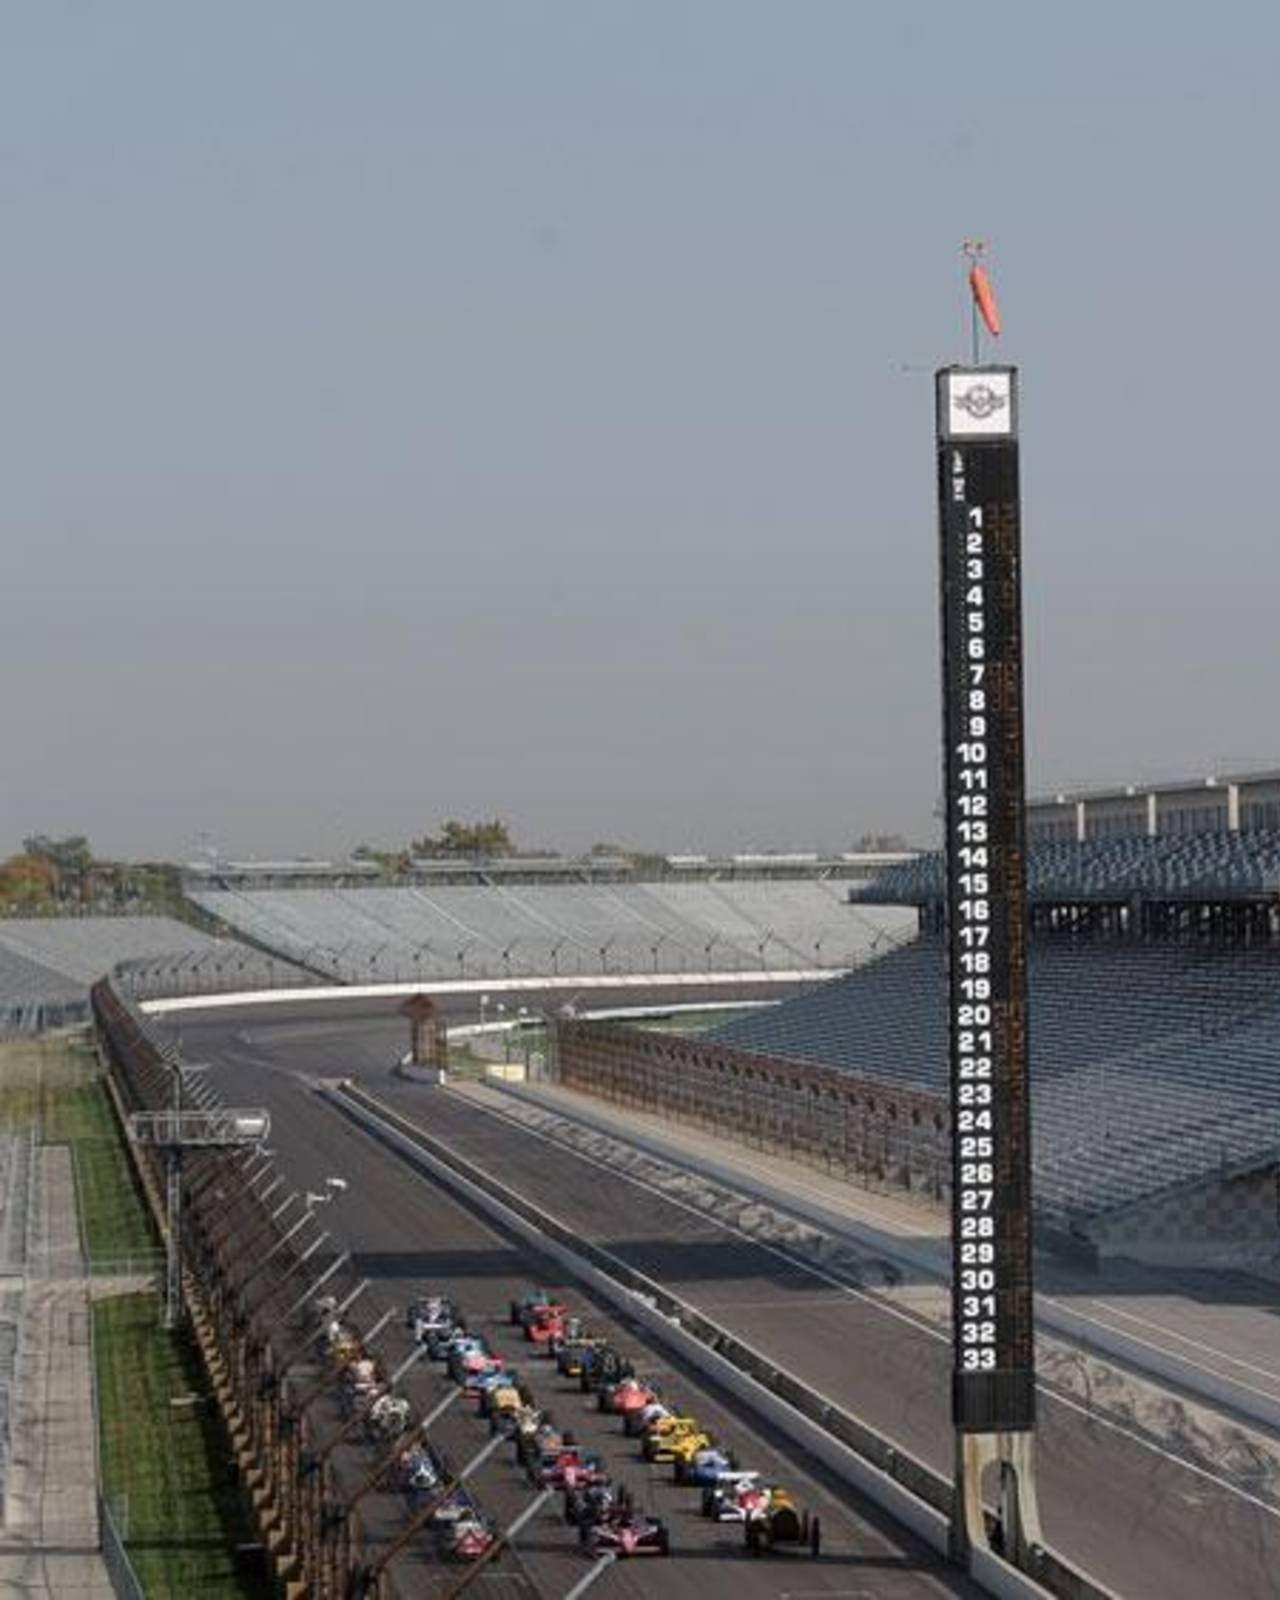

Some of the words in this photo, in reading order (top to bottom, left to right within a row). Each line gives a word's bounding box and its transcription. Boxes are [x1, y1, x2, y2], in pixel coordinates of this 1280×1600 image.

[968, 506, 983, 528] 1
[966, 532, 983, 554] 2
[966, 558, 983, 580] 3
[966, 585, 984, 607] 4
[968, 611, 984, 633] 5
[968, 637, 985, 659] 6
[969, 664, 985, 686] 7
[969, 689, 986, 711] 8
[969, 716, 986, 738] 9
[956, 742, 987, 764] 10
[959, 768, 987, 790] 11
[957, 794, 987, 816] 12
[957, 820, 988, 842] 13
[958, 847, 988, 869] 14
[958, 873, 989, 895] 15
[958, 899, 989, 921] 16
[959, 925, 990, 947] 17
[959, 951, 990, 973] 18
[960, 978, 991, 1000] 19
[957, 1004, 991, 1026] 20
[958, 1030, 992, 1052] 21
[959, 1057, 992, 1079] 22
[958, 1083, 992, 1105] 23
[958, 1109, 992, 1131] 24
[960, 1136, 993, 1158] 25
[961, 1162, 994, 1184] 26
[961, 1189, 994, 1211] 27
[960, 1216, 994, 1238] 28
[960, 1242, 994, 1264] 29
[960, 1269, 995, 1291] 30
[962, 1295, 996, 1317] 31
[962, 1321, 996, 1343] 32
[963, 1347, 996, 1369] 33
